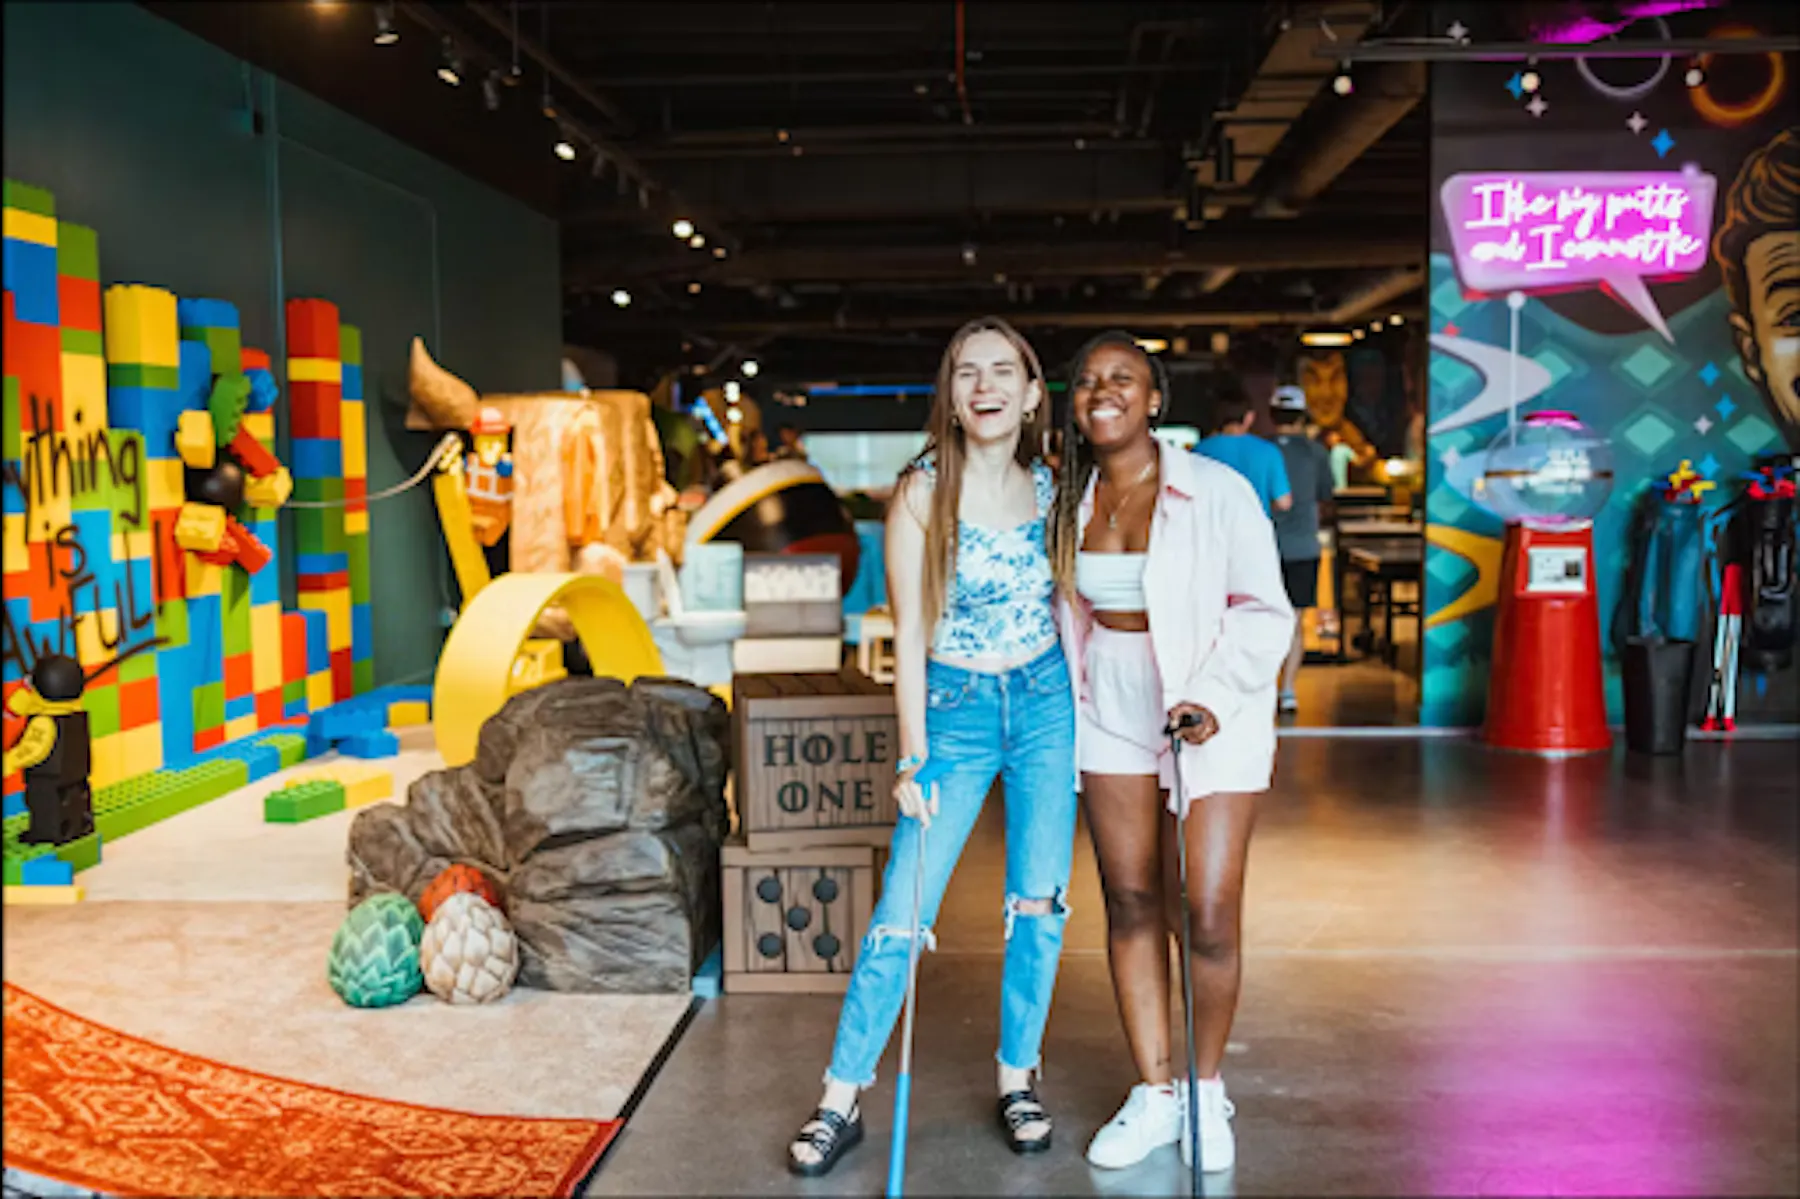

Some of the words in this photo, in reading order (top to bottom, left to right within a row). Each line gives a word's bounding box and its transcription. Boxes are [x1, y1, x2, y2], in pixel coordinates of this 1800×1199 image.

[1525, 225, 1567, 271] I
[44, 519, 87, 589] is
[763, 731, 889, 767] HOLE
[776, 779, 876, 814] ONE
